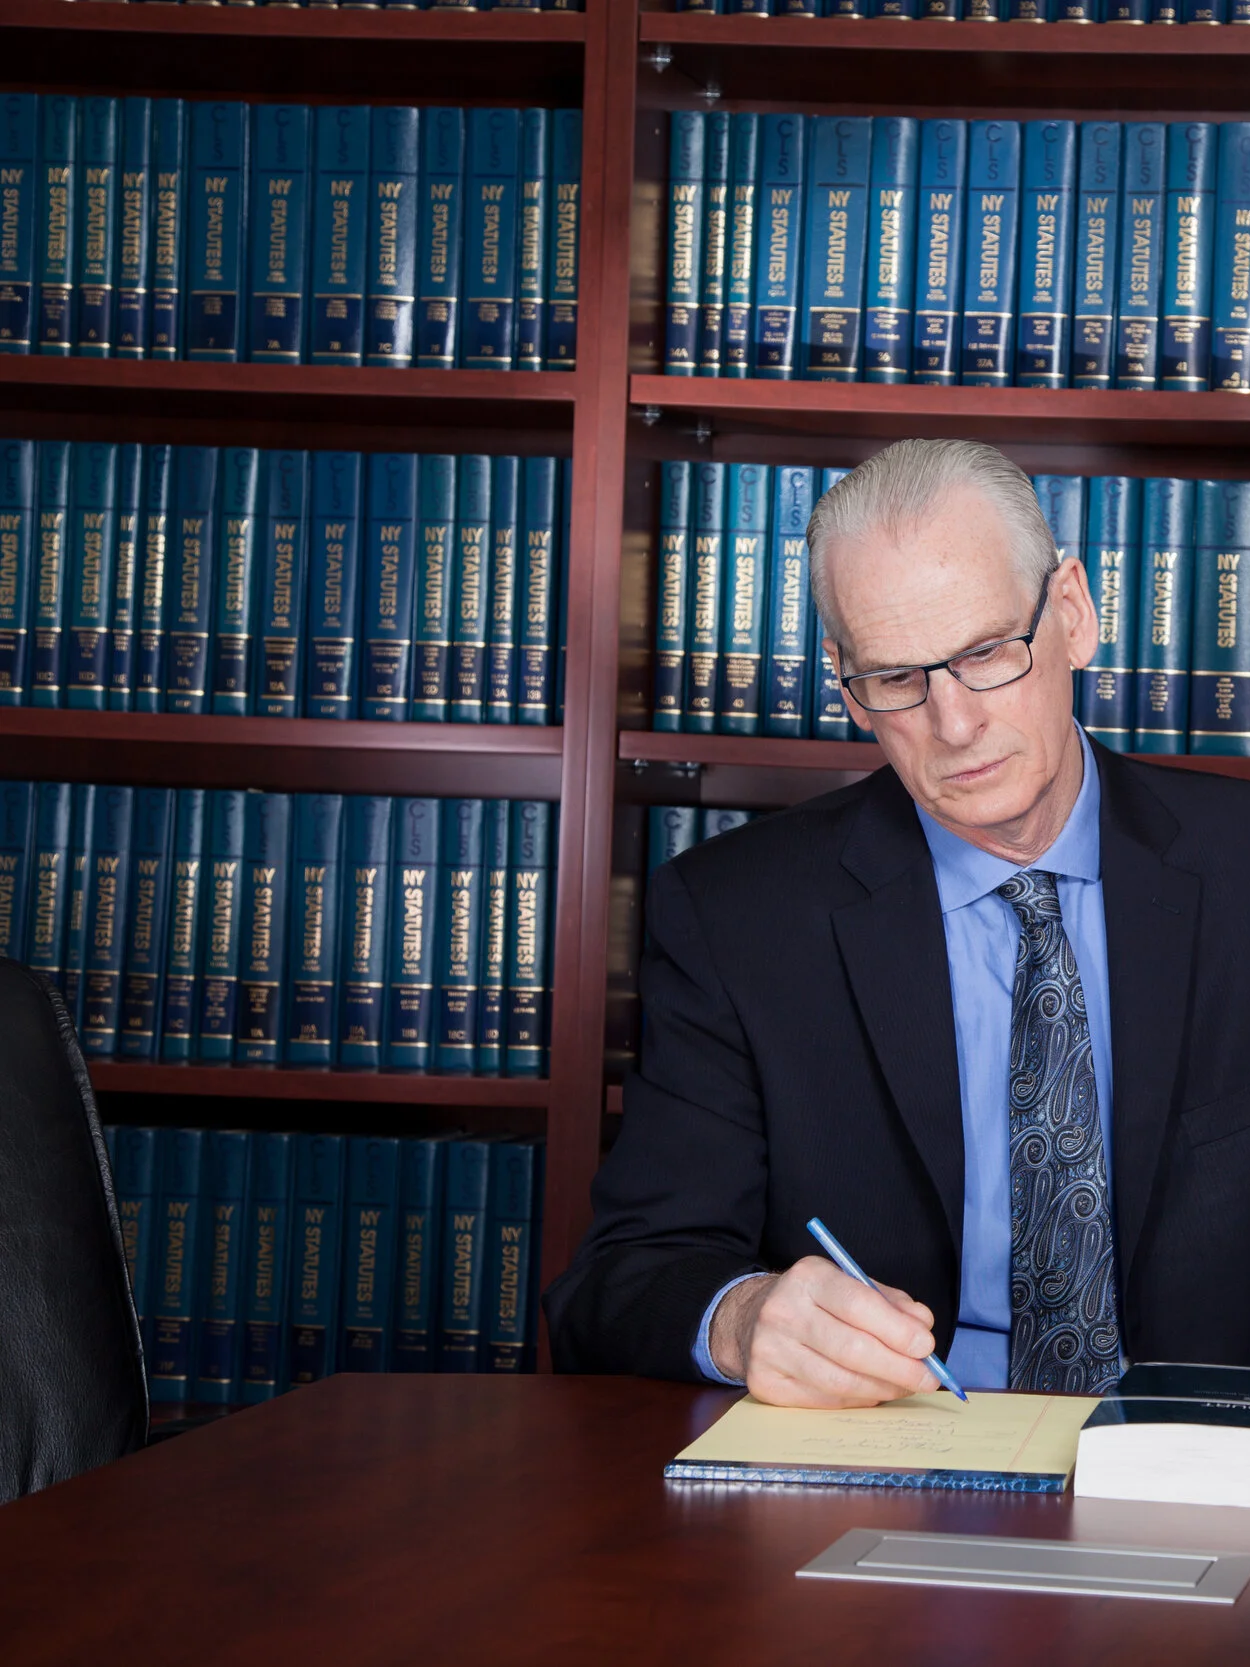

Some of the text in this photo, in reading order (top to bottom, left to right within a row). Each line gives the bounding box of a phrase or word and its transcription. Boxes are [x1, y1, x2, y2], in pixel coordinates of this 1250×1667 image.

[48, 187, 67, 260] STATUTES
[87, 188, 105, 260] STATUTES
[206, 197, 223, 267] STATUTES
[269, 199, 287, 269] STATUTES
[379, 202, 397, 273] STATUTES
[522, 206, 539, 270] STATUTES
[557, 202, 577, 278] STATUTES
[673, 185, 697, 279] NY STATUTES
[732, 204, 753, 279] STATUTES
[768, 190, 792, 282] NY STATUTES
[827, 191, 850, 284] NY STATUTES
[879, 190, 903, 284] NY STATUTES
[928, 193, 953, 287] NY STATUTES
[980, 195, 1004, 288] NY STATUTES
[1035, 195, 1059, 289] NY STATUTES
[1085, 198, 1108, 291] NY STATUTES
[1130, 199, 1154, 292] NY STATUTES
[1176, 197, 1200, 291] NY STATUTES
[1231, 232, 1250, 300] STATUTES
[39, 513, 63, 605] NY STATUTES
[226, 519, 250, 611] NY STATUTES
[273, 524, 296, 614] NY STATUTES
[380, 545, 399, 616] STATUTES
[424, 527, 446, 619] NY STATUTES
[461, 527, 484, 619] NY STATUTES
[528, 530, 551, 623] NY STATUTES
[663, 535, 684, 627] NY STATUTES
[695, 537, 719, 629] NY STATUTES
[734, 537, 757, 631] NY STATUTES
[781, 540, 804, 633] NY STATUTES
[1100, 551, 1124, 644] NY STATUTES
[1152, 552, 1177, 646] NY STATUTES
[1217, 554, 1240, 648] NY STATUTES
[96, 877, 116, 947] STATUTES
[211, 880, 232, 953] STATUTES
[252, 887, 273, 958] STATUTES
[353, 886, 373, 960] STATUTES
[402, 869, 426, 962] NY STATUTES
[450, 889, 470, 962] STATUTES
[516, 872, 539, 965] NY STATUTES
